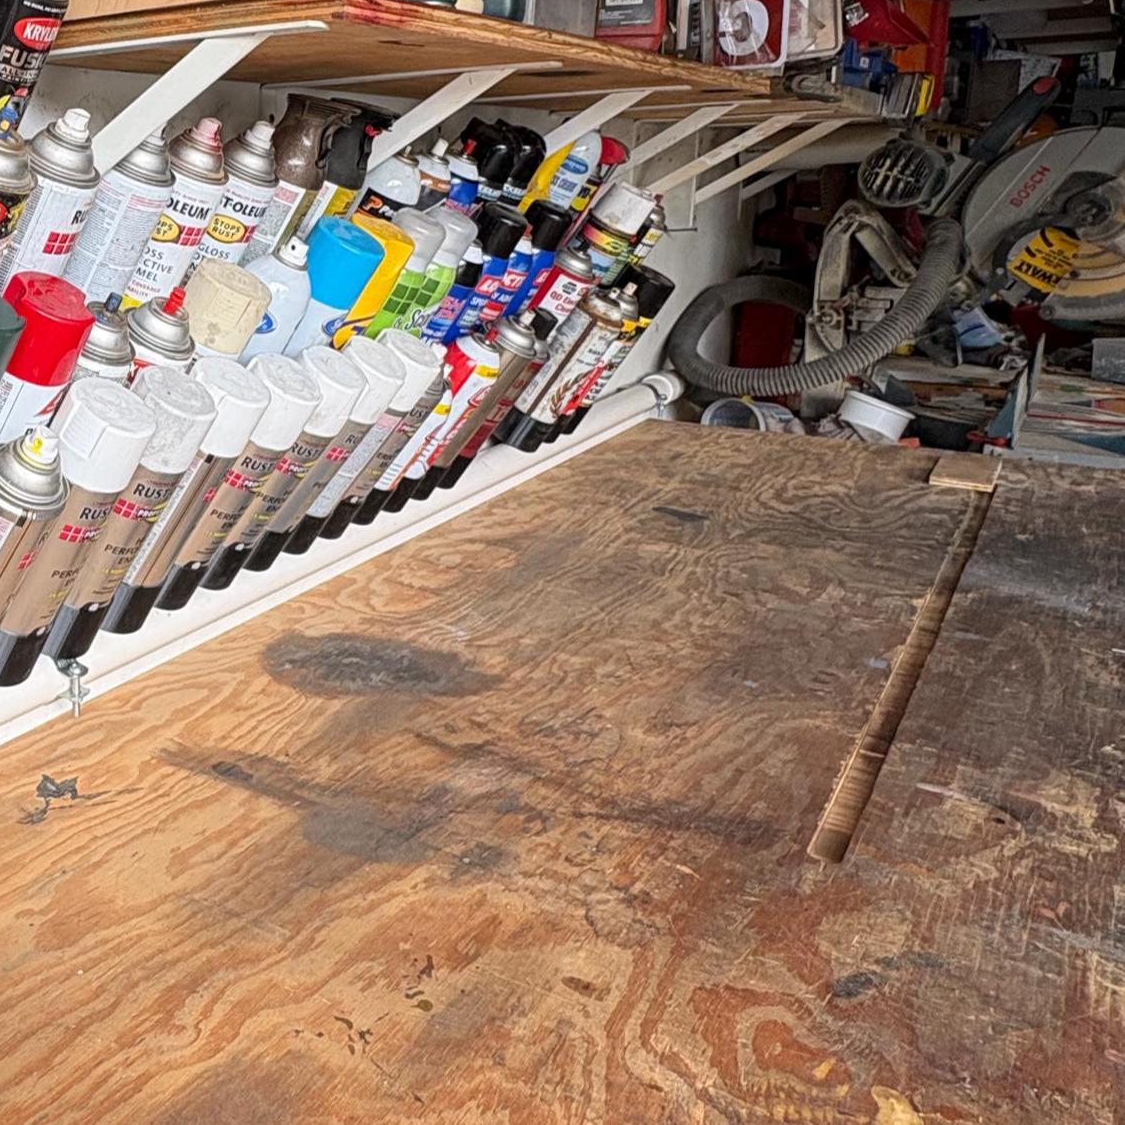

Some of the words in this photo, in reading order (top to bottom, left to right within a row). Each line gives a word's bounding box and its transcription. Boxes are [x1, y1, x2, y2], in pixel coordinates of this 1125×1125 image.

[1010, 165, 1051, 208] BOSCH
[212, 226, 235, 239] RUST
[214, 218, 241, 233] STOPS
